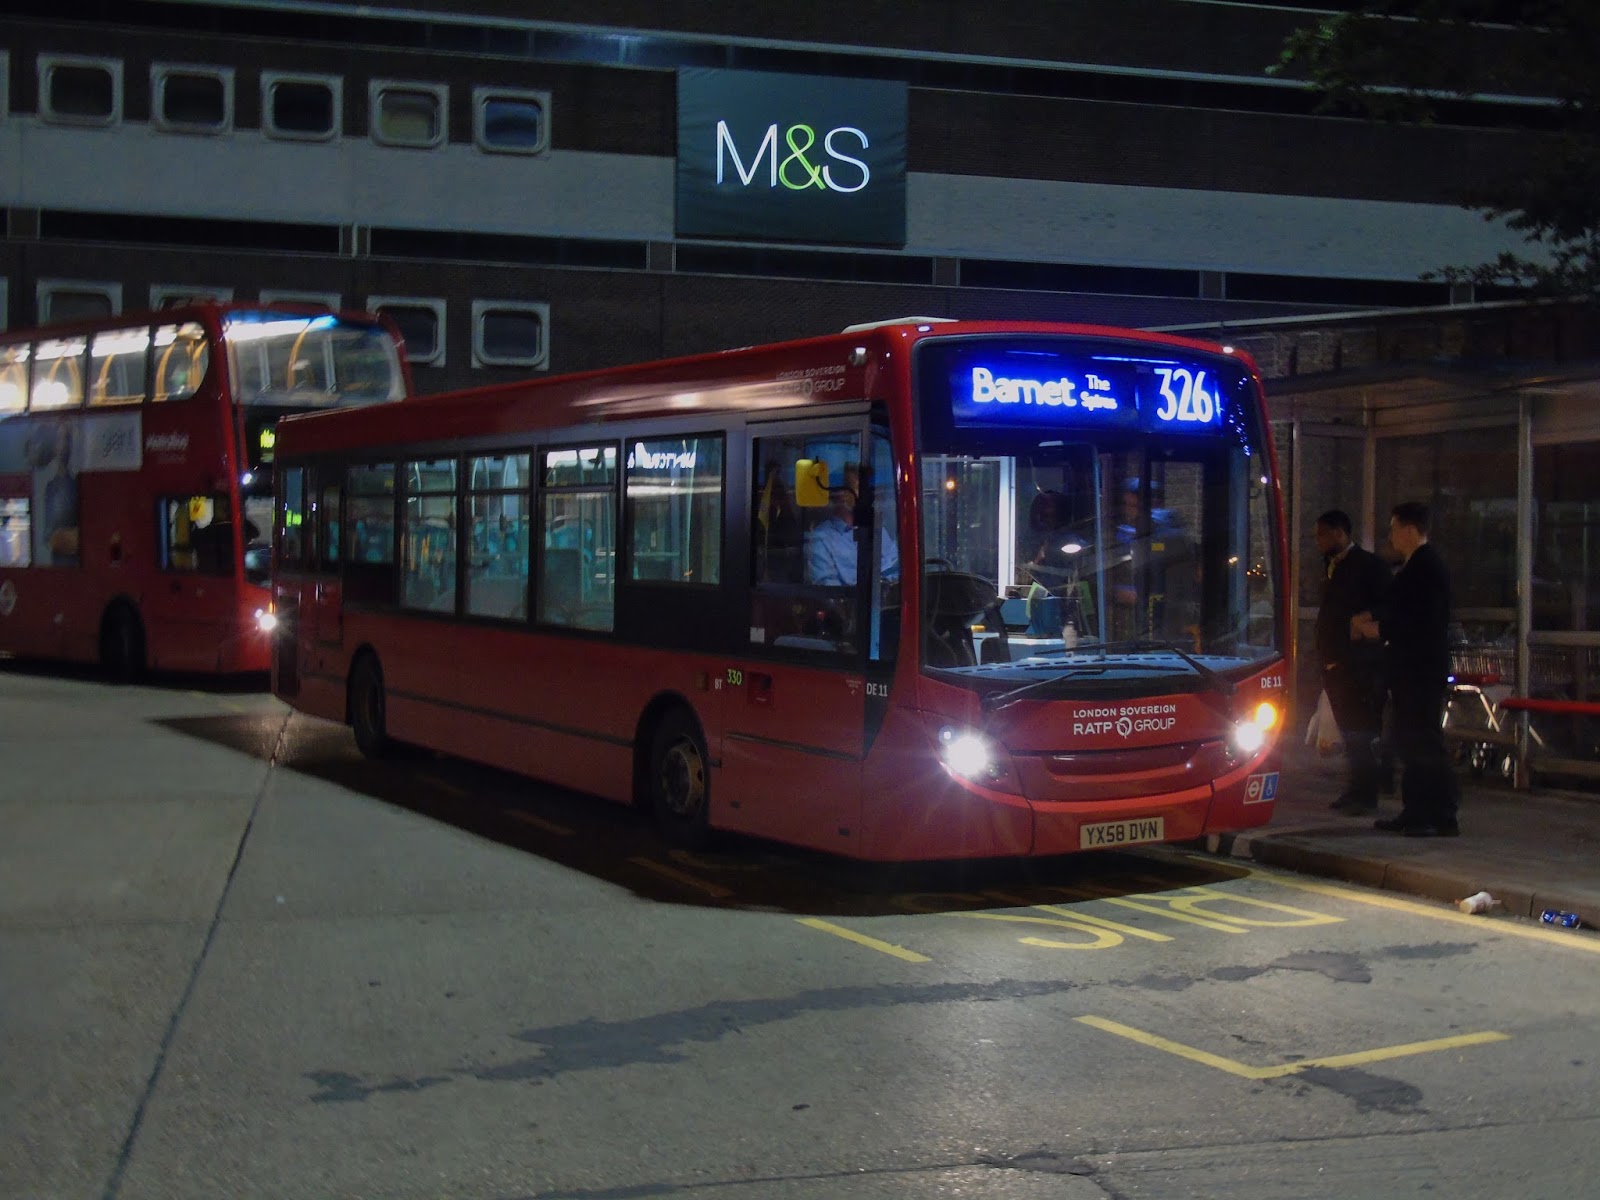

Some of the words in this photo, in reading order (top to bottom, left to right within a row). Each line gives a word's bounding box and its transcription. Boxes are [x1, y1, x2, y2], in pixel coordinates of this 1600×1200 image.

[717, 120, 870, 193] M&S
[971, 367, 1077, 407] Barnet
[1084, 374, 1111, 391] The
[1154, 368, 1213, 423] 326
[727, 668, 742, 686] 330
[1260, 676, 1272, 688] DE
[1273, 676, 1282, 687] 11
[866, 682, 877, 696] DE
[878, 684, 888, 698] 11
[1073, 707, 1117, 719] LONDON
[1119, 704, 1176, 716] SOVEREIGN
[1073, 721, 1113, 736] RATP
[1134, 717, 1176, 732] GROUP
[1086, 825, 1126, 846] YX58
[1129, 820, 1158, 841] DVN
